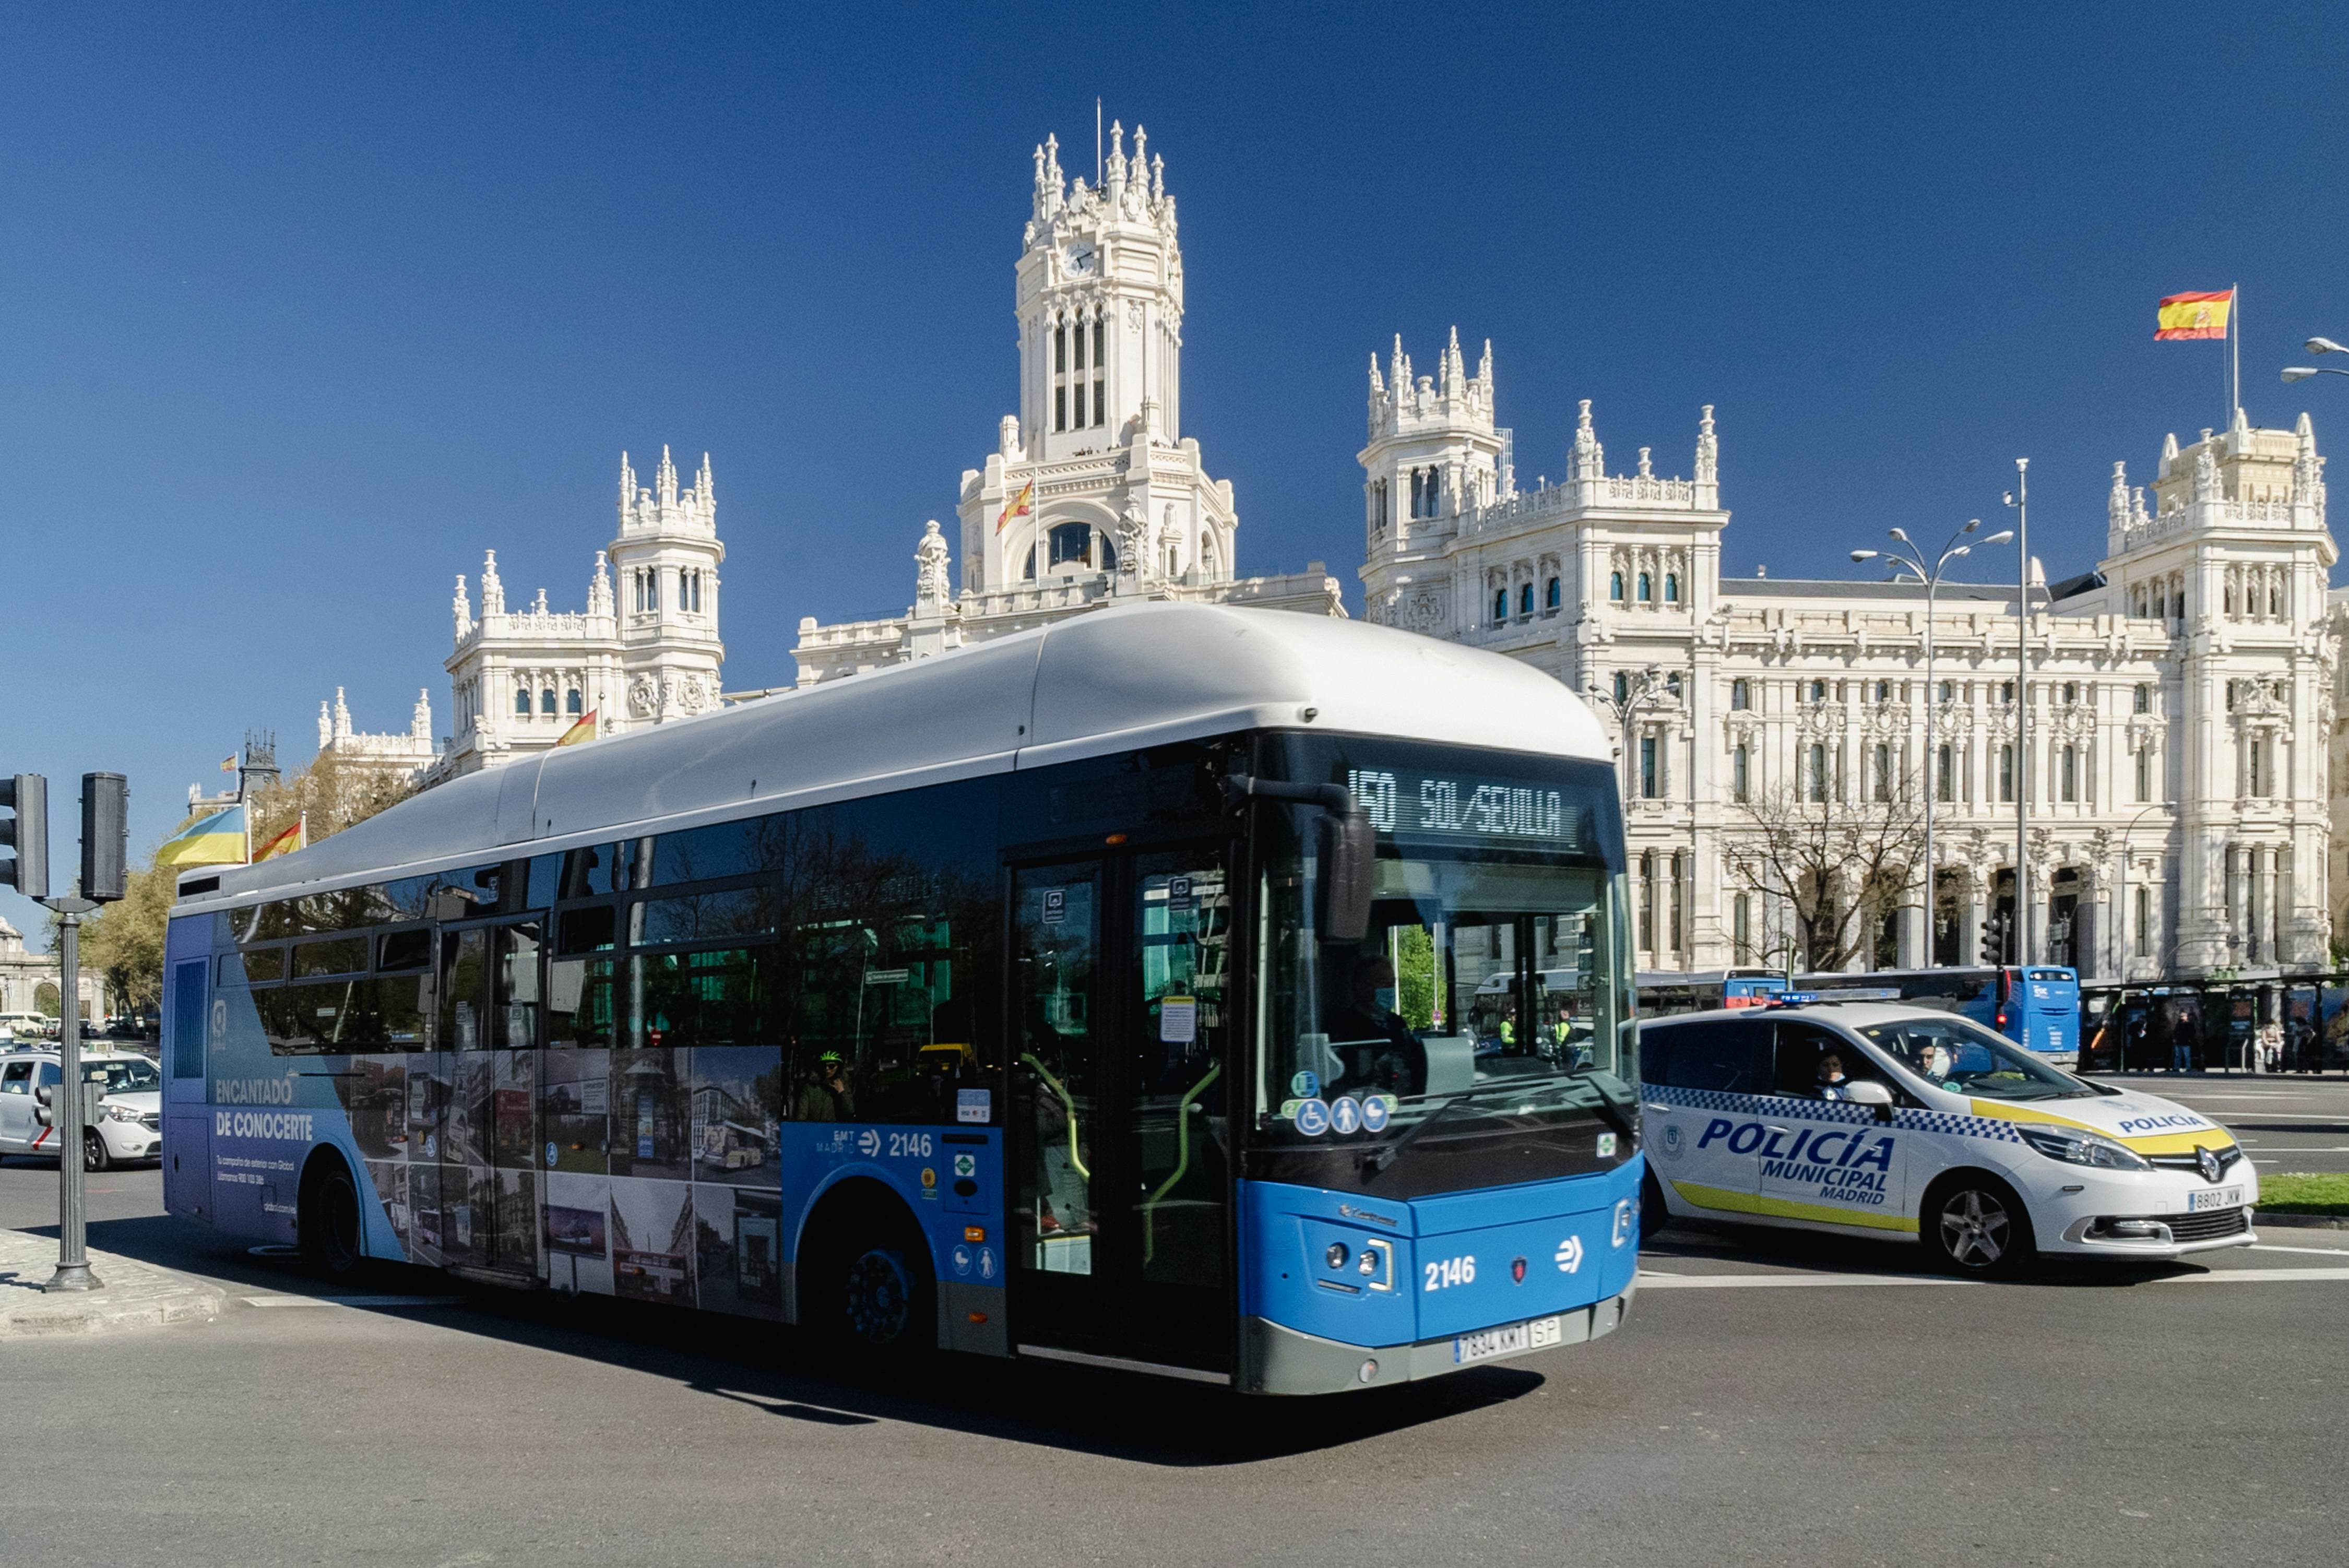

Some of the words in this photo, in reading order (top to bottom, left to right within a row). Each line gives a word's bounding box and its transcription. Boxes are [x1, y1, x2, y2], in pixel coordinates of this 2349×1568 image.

[1419, 779, 1561, 836] SOL/SEVILLA
[216, 1078, 292, 1105] ENCANTADO
[1286, 1103, 1296, 1113] 2
[216, 1112, 231, 1136] DE
[234, 1112, 313, 1142] CONOCERTE
[2118, 1113, 2207, 1133] POLICÍA
[833, 1130, 855, 1142] EMT
[888, 1133, 933, 1157] 2146
[1696, 1118, 1895, 1171] POLICÍA
[1761, 1160, 1887, 1192] MUNICIPAL
[1819, 1186, 1885, 1205] MADRID
[2196, 1192, 2222, 1209] 8802
[1424, 1255, 1476, 1292] 2146
[1535, 1319, 1557, 1343] SP
[1462, 1334, 1496, 1360] 7834
